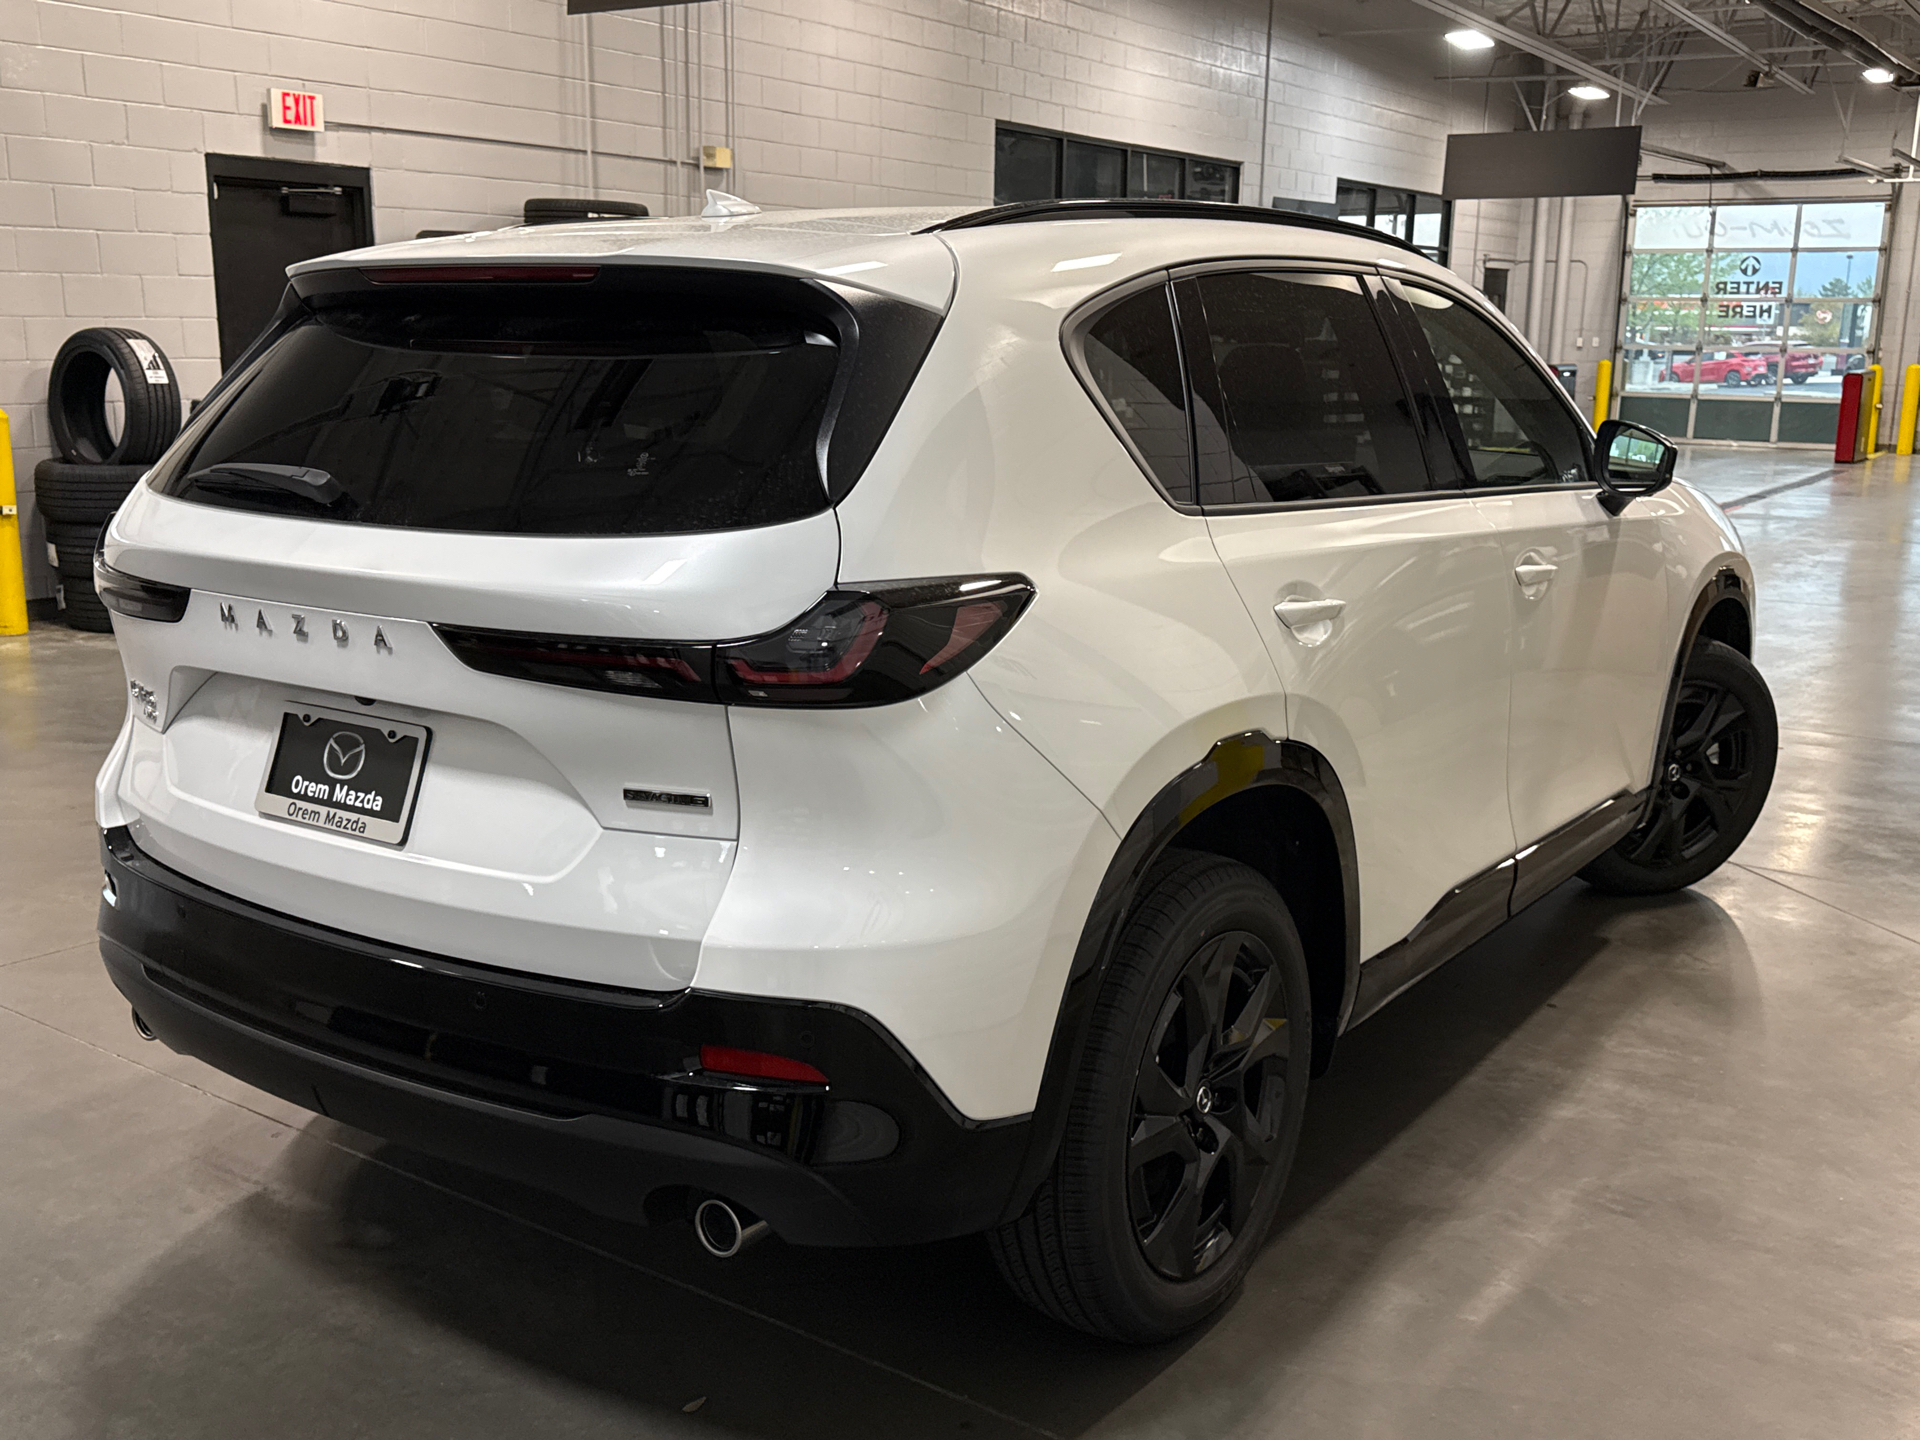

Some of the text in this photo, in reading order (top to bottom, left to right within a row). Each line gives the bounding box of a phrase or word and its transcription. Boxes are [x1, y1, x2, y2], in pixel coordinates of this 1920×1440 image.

[281, 91, 316, 127] EXIT
[220, 602, 393, 652] MAZDA
[291, 774, 383, 812] Orem Mazda
[287, 801, 367, 834] Orem Mazda
